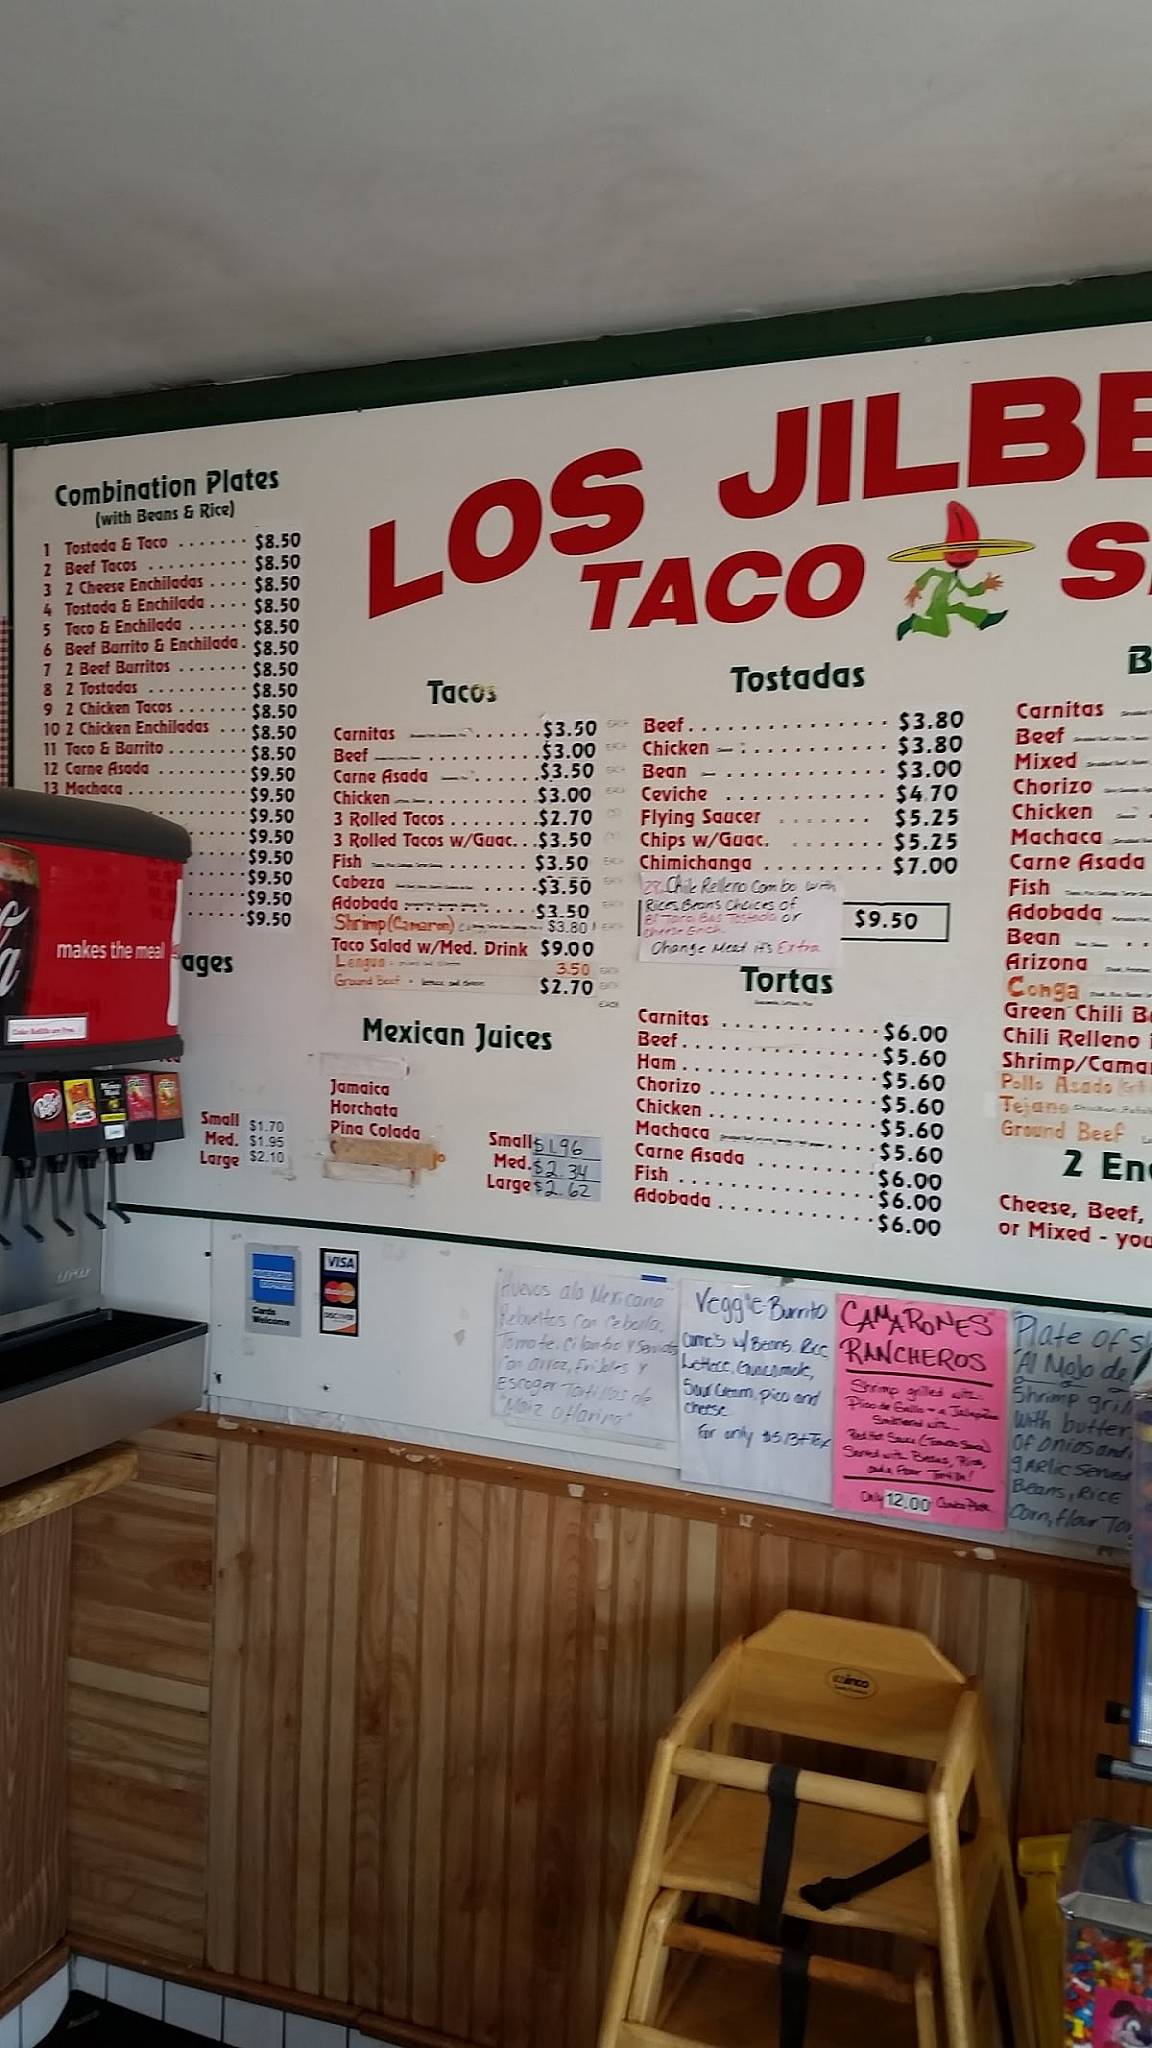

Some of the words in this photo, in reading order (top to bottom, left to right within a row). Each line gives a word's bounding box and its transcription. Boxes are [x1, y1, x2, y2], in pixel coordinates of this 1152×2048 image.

[55, 473, 197, 507] Combination
[206, 469, 279, 495] Plates
[96, 509, 132, 528] (with
[137, 506, 178, 523] Beans
[184, 504, 194, 519] &
[200, 500, 235, 519] Rice)
[43, 543, 50, 557] 1
[64, 539, 117, 556] Tostada
[121, 537, 132, 552] &
[138, 535, 169, 550] Taco
[255, 532, 301, 550] $8.50
[369, 447, 645, 620] LOS
[43, 563, 51, 577] 2
[64, 560, 96, 576] Beef
[101, 558, 137, 573] Tacos
[255, 554, 301, 572] $8.50
[43, 583, 51, 597] 3
[66, 582, 73, 596] 2
[79, 579, 125, 595] Cheese
[130, 575, 204, 592] Enchiladas
[254, 575, 300, 594] $8.50
[579, 543, 865, 631] TACO
[730, 662, 866, 693] Tostadas
[427, 680, 498, 705] Tacos
[643, 716, 685, 733] Beef
[899, 710, 965, 732] $3.80
[1017, 701, 1105, 720] Carnitas
[332, 727, 395, 742] Carnitas
[543, 720, 597, 740] $3.50
[333, 748, 369, 763] Beef
[542, 742, 596, 760] $3.00
[642, 740, 710, 757] Chicken
[898, 735, 964, 756] $3.80
[44, 762, 58, 776] 12
[65, 762, 104, 776] Carne
[108, 761, 150, 776] Asada
[250, 767, 295, 783] $9.50
[642, 763, 687, 779] Bean
[897, 759, 962, 781] $3.00
[1014, 751, 1078, 771] Mixed
[333, 769, 377, 784] Carne
[382, 768, 428, 784] Asada
[540, 763, 595, 782] $3.50
[44, 782, 58, 795] 13
[65, 781, 123, 796] Machaca
[249, 787, 295, 804] $9.50
[641, 785, 708, 802] Ceviche
[896, 783, 958, 805] $4.70
[1013, 777, 1093, 795] Chorizo
[640, 809, 695, 827] Flying
[701, 808, 761, 825] Saucer
[895, 807, 959, 829] $5.25
[1012, 803, 1093, 821] Chicken
[333, 833, 342, 848] 3
[349, 832, 397, 848] Rolled
[403, 833, 445, 848] Tacos
[538, 832, 592, 850] $3.50
[639, 831, 686, 850] Chips
[692, 831, 769, 848] w/Guac.
[894, 832, 959, 853] $5.25
[1010, 828, 1104, 846] Machaca
[332, 854, 362, 869] Fish
[535, 854, 589, 873] $3.50
[639, 854, 753, 873] Chimichanga
[893, 856, 958, 876] $7.00
[1010, 853, 1071, 871] Carne
[1078, 852, 1146, 872] Asada
[332, 875, 385, 890] Cabeza
[537, 878, 592, 896] $3.50
[332, 895, 399, 911] Adobada
[536, 903, 590, 920] $3.50
[547, 920, 588, 934] $3.80
[855, 908, 918, 930] $9.50
[331, 937, 367, 953] Taco
[370, 938, 411, 955] Salad
[417, 939, 478, 956] w/Med.
[484, 940, 528, 957] Drink
[541, 939, 594, 957] $9.00
[1007, 927, 1061, 946] Bean
[57, 939, 107, 960] makes
[110, 940, 132, 959] the
[135, 941, 165, 960] meal
[1006, 953, 1089, 972] Arizona
[540, 979, 594, 996] $2.70
[740, 965, 834, 995] Tortas
[1007, 975, 1080, 1003] Conga
[1004, 1001, 1066, 1021] Green
[1075, 1004, 1123, 1023] Chili
[362, 1017, 465, 1047] Mexican
[475, 1022, 552, 1053] Juices
[637, 1008, 710, 1028] Carnitas
[883, 1022, 948, 1044] $6.00
[637, 1030, 678, 1049] Beef
[883, 1046, 947, 1068] $5.60
[1003, 1026, 1050, 1046] Chili
[1058, 1028, 1141, 1050] Relleno
[637, 1052, 677, 1071] Ham
[882, 1070, 946, 1092] $5.60
[330, 1078, 390, 1097] Jamaica
[636, 1075, 702, 1094] Chorizo
[881, 1094, 945, 1116] $5.60
[330, 1099, 399, 1118] Horchata
[200, 1111, 240, 1127] Small
[249, 1119, 285, 1134] $1.70
[330, 1120, 365, 1137] Pina
[369, 1122, 421, 1140] Colada
[205, 1131, 239, 1148] Med.
[249, 1135, 285, 1149] $1.95
[489, 1131, 532, 1149] Small
[635, 1120, 710, 1140] Machaca
[880, 1142, 943, 1164] $5.60
[200, 1151, 240, 1169] Large
[249, 1150, 285, 1164] $2.10
[494, 1153, 532, 1171] Med.
[533, 1158, 588, 1180] $2.34
[635, 1142, 684, 1161] Carne
[690, 1147, 745, 1166] Asada
[878, 1169, 943, 1191] $6.00
[1062, 1149, 1083, 1177] 2
[1102, 1151, 1152, 1182] En
[487, 1173, 531, 1194] Large
[533, 1180, 592, 1198] $2.62
[633, 1186, 711, 1208] Adobada
[878, 1213, 941, 1237] $6.00
[999, 1193, 1078, 1220] Cheese,
[1088, 1201, 1145, 1225] Beef,
[999, 1221, 1020, 1237] or
[1028, 1220, 1091, 1244] Mixed
[327, 1255, 355, 1270] VISA
[251, 1306, 277, 1317] Cards
[251, 1315, 291, 1327] Welcome
[840, 1300, 993, 1338] CAMARONES
[1013, 1313, 1082, 1348] Plate
[839, 1336, 987, 1372] RANCHEROS
[885, 1491, 931, 1513] 12.00
